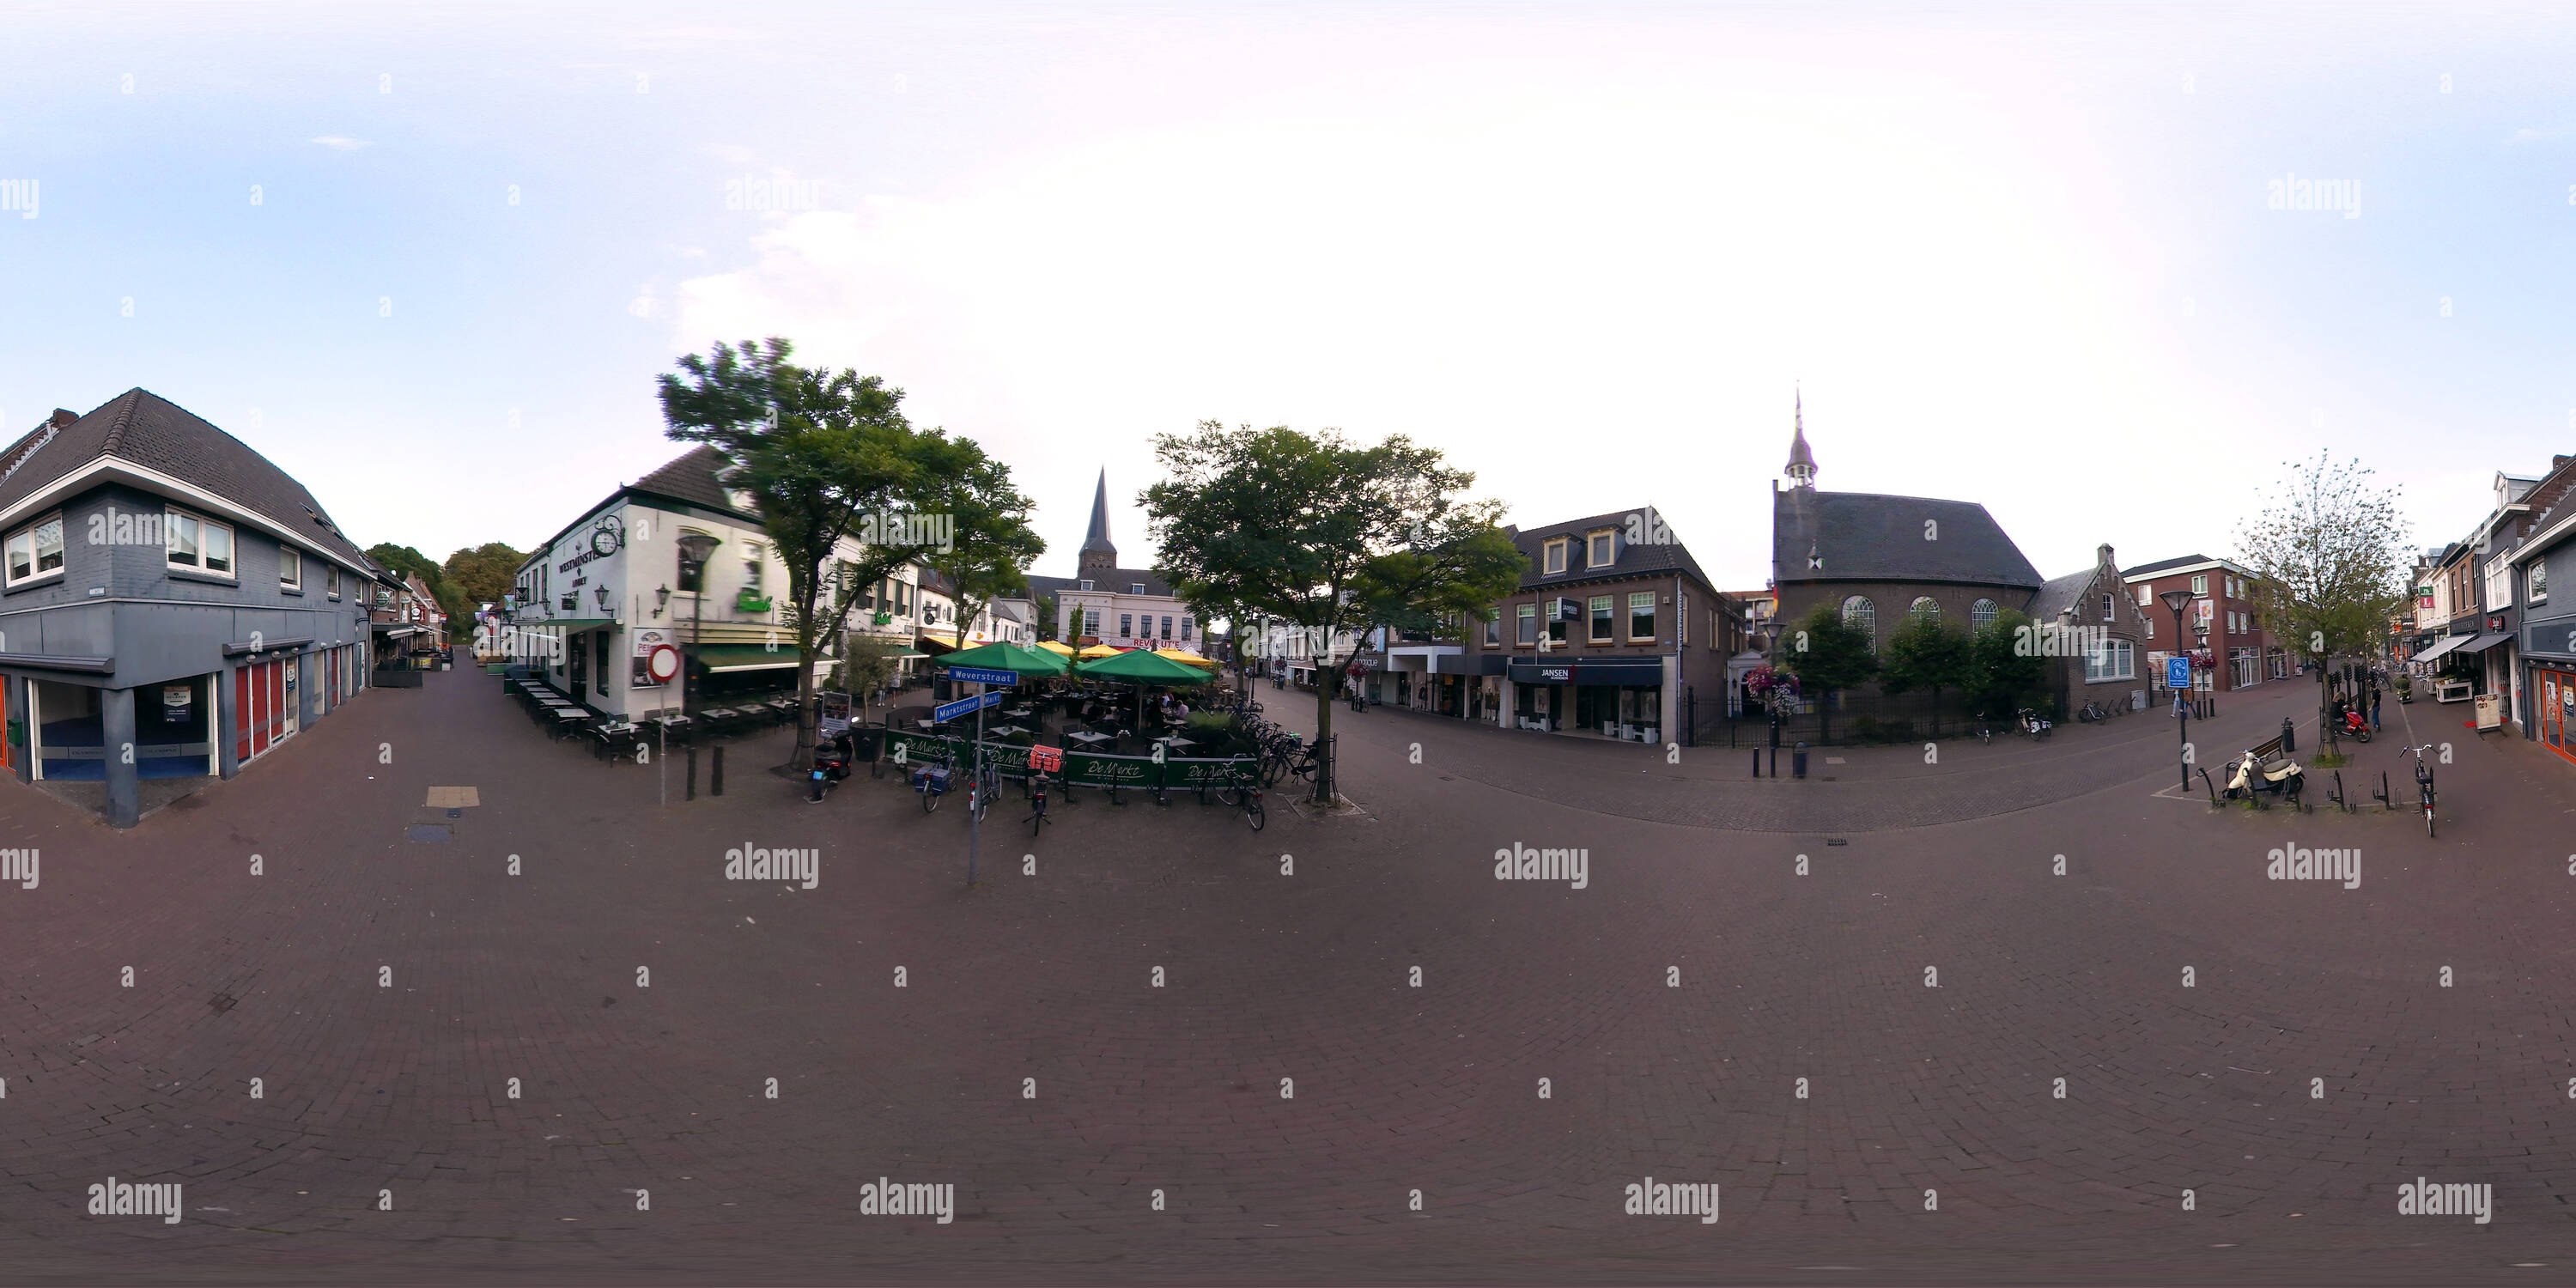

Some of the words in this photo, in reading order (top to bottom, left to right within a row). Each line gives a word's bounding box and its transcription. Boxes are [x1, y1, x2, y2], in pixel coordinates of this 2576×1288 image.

[559, 550, 601, 574] WESTMINSTE
[956, 671, 1011, 683] Weverstraat
[985, 695, 999, 703] Markt
[939, 700, 978, 719] Marktstraat
[991, 750, 1005, 762] De
[1088, 759, 1103, 773] De
[1103, 762, 1139, 775] Markt
[1188, 764, 1203, 777] De
